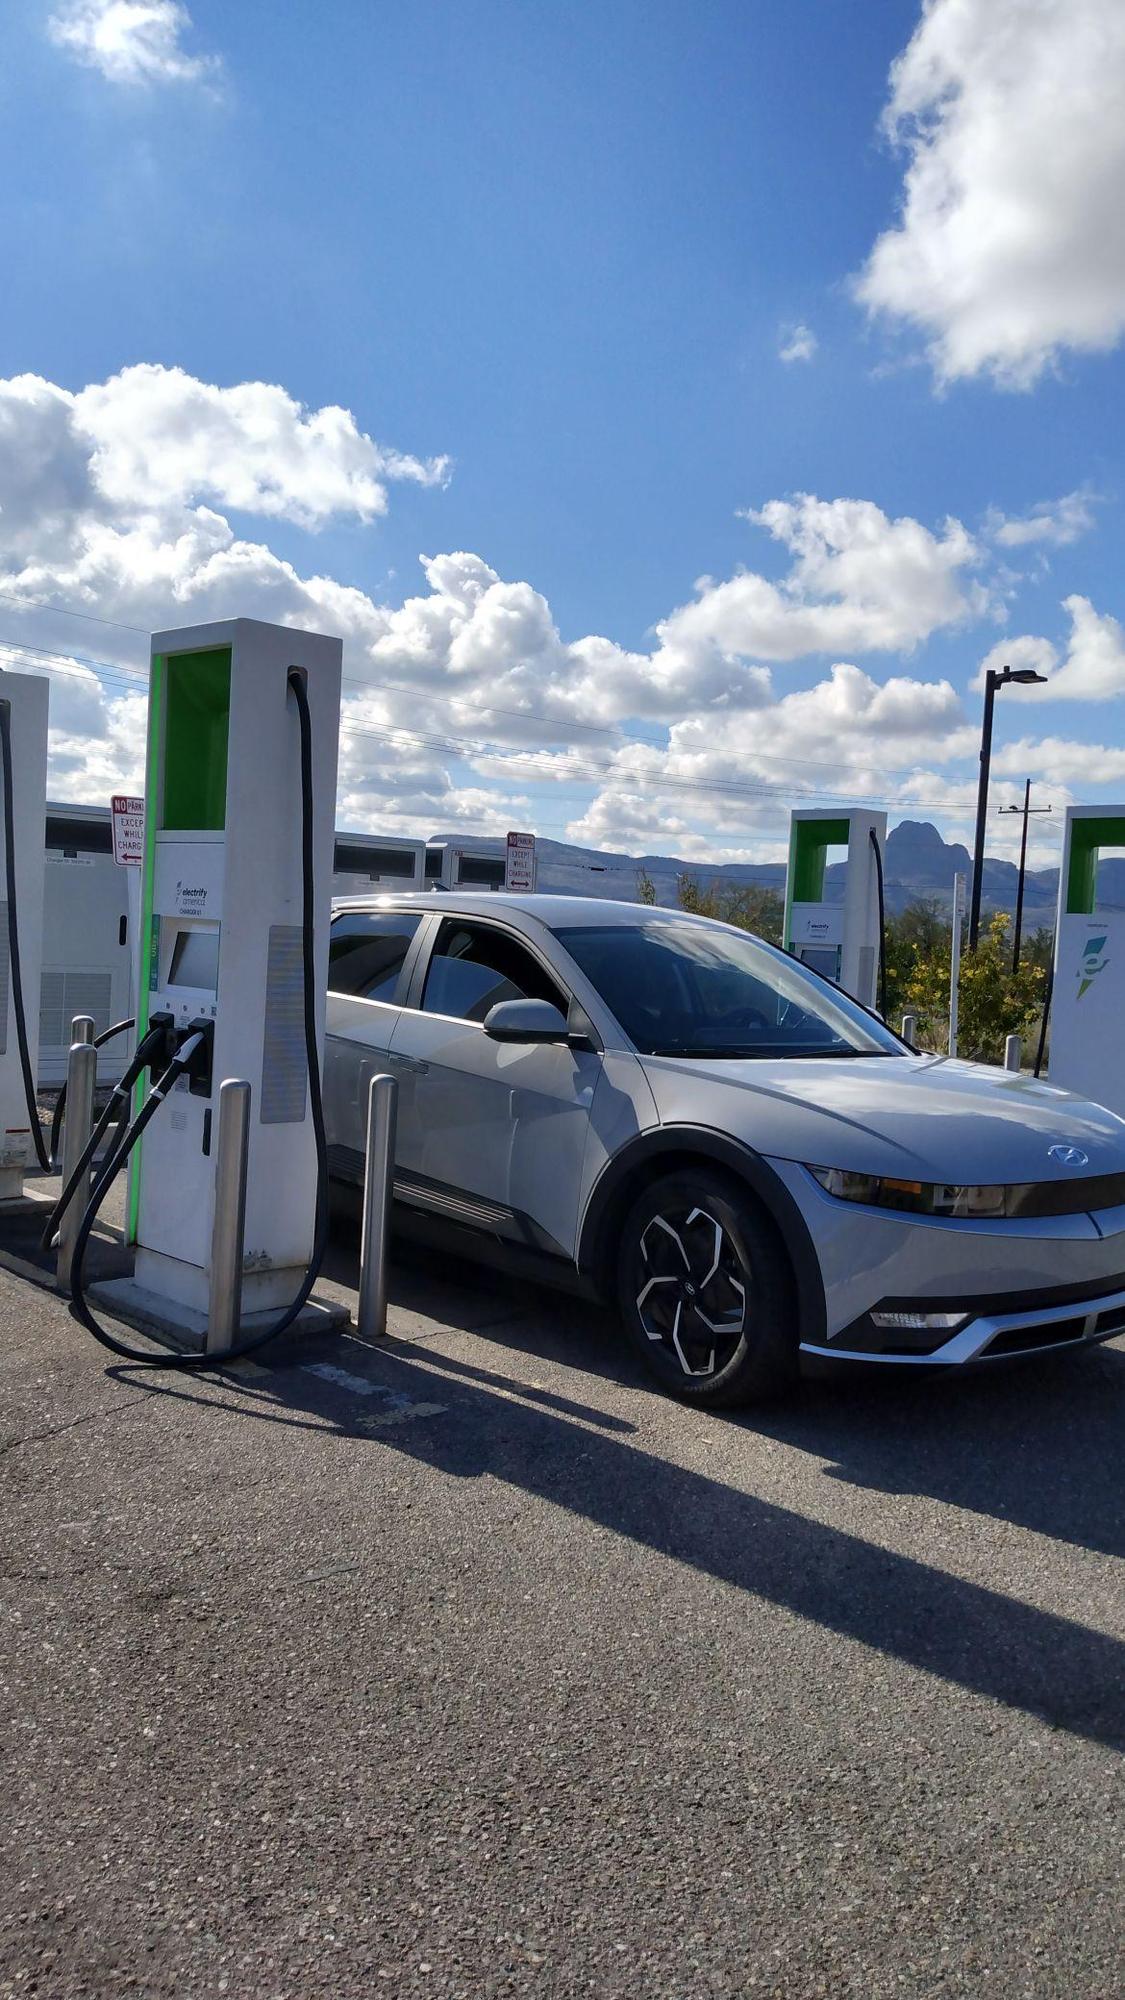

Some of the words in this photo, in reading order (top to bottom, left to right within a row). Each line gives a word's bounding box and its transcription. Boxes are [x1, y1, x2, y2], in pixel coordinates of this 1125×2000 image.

[115, 799, 126, 812] NO
[121, 818, 144, 828] EXCEP
[118, 841, 142, 851] CHARG
[182, 888, 208, 898] electrify
[182, 898, 206, 906] america
